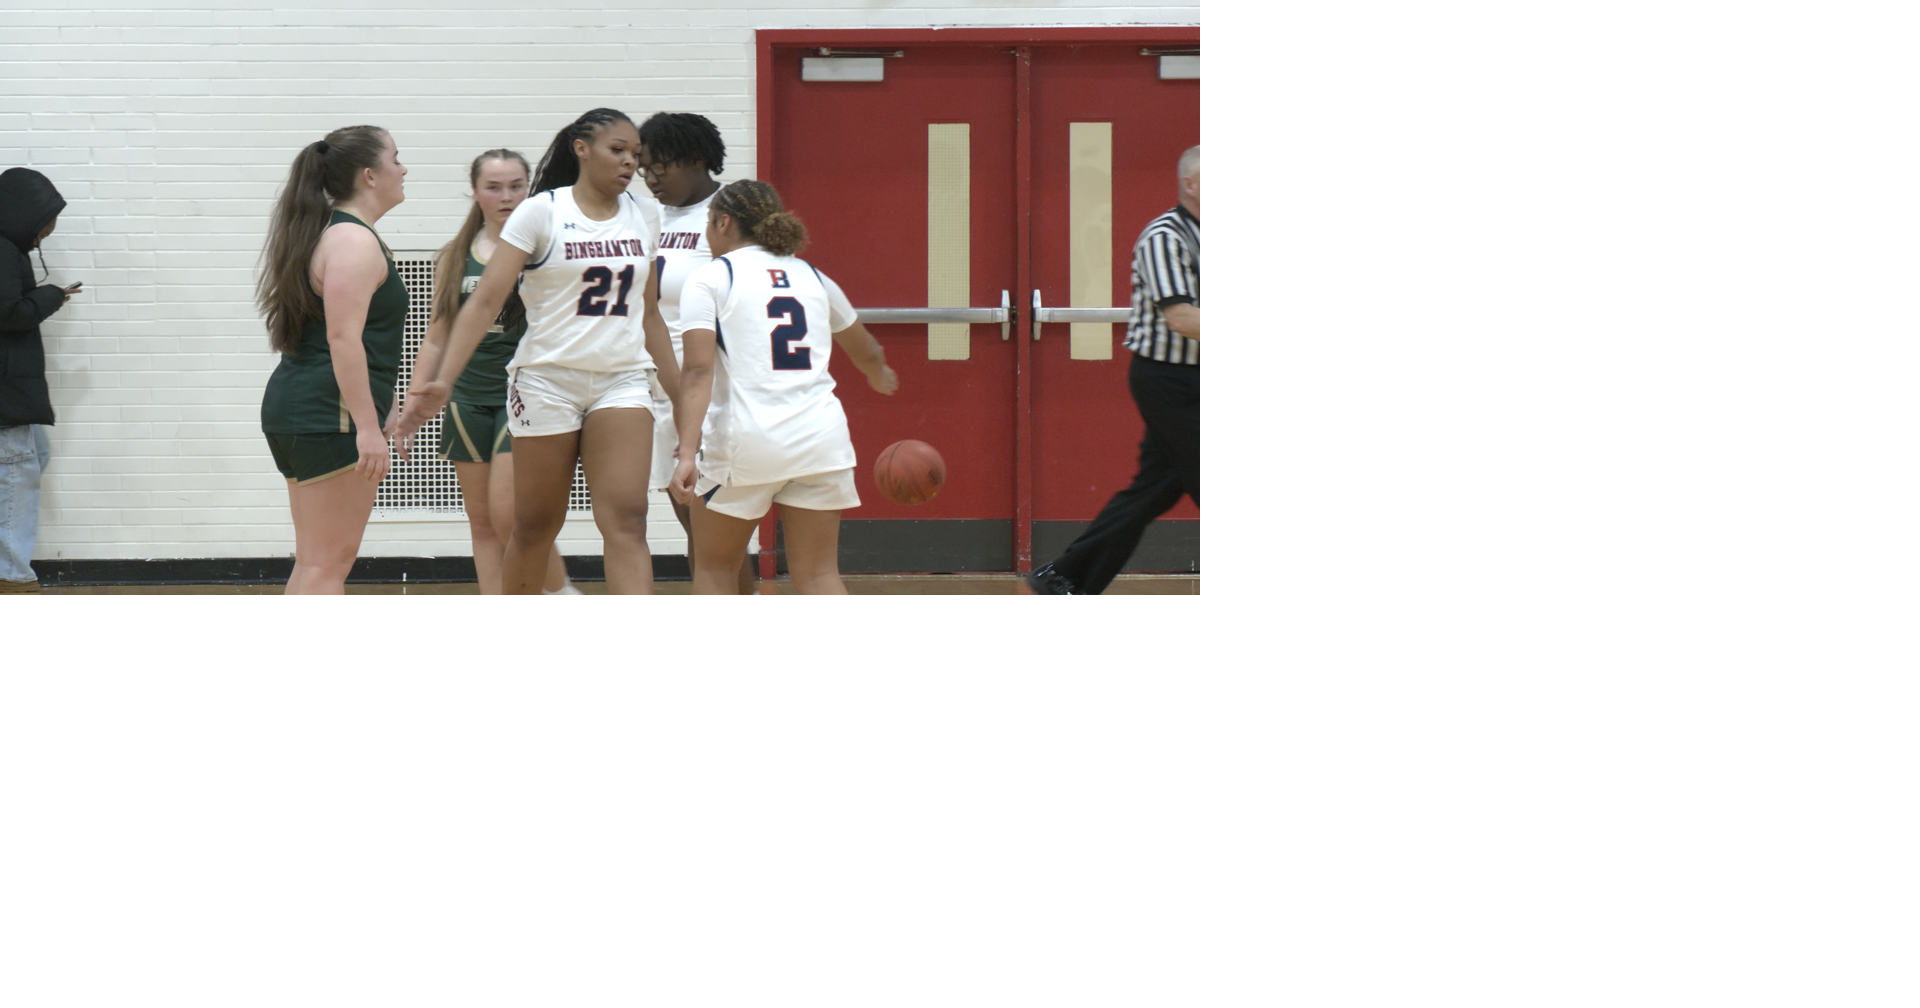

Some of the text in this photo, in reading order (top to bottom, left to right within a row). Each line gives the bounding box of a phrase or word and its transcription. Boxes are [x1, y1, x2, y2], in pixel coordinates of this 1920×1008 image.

[564, 239, 645, 260] BINGHAMTON
[576, 264, 634, 317] 21
[766, 269, 791, 289] B
[766, 296, 812, 371] 2
